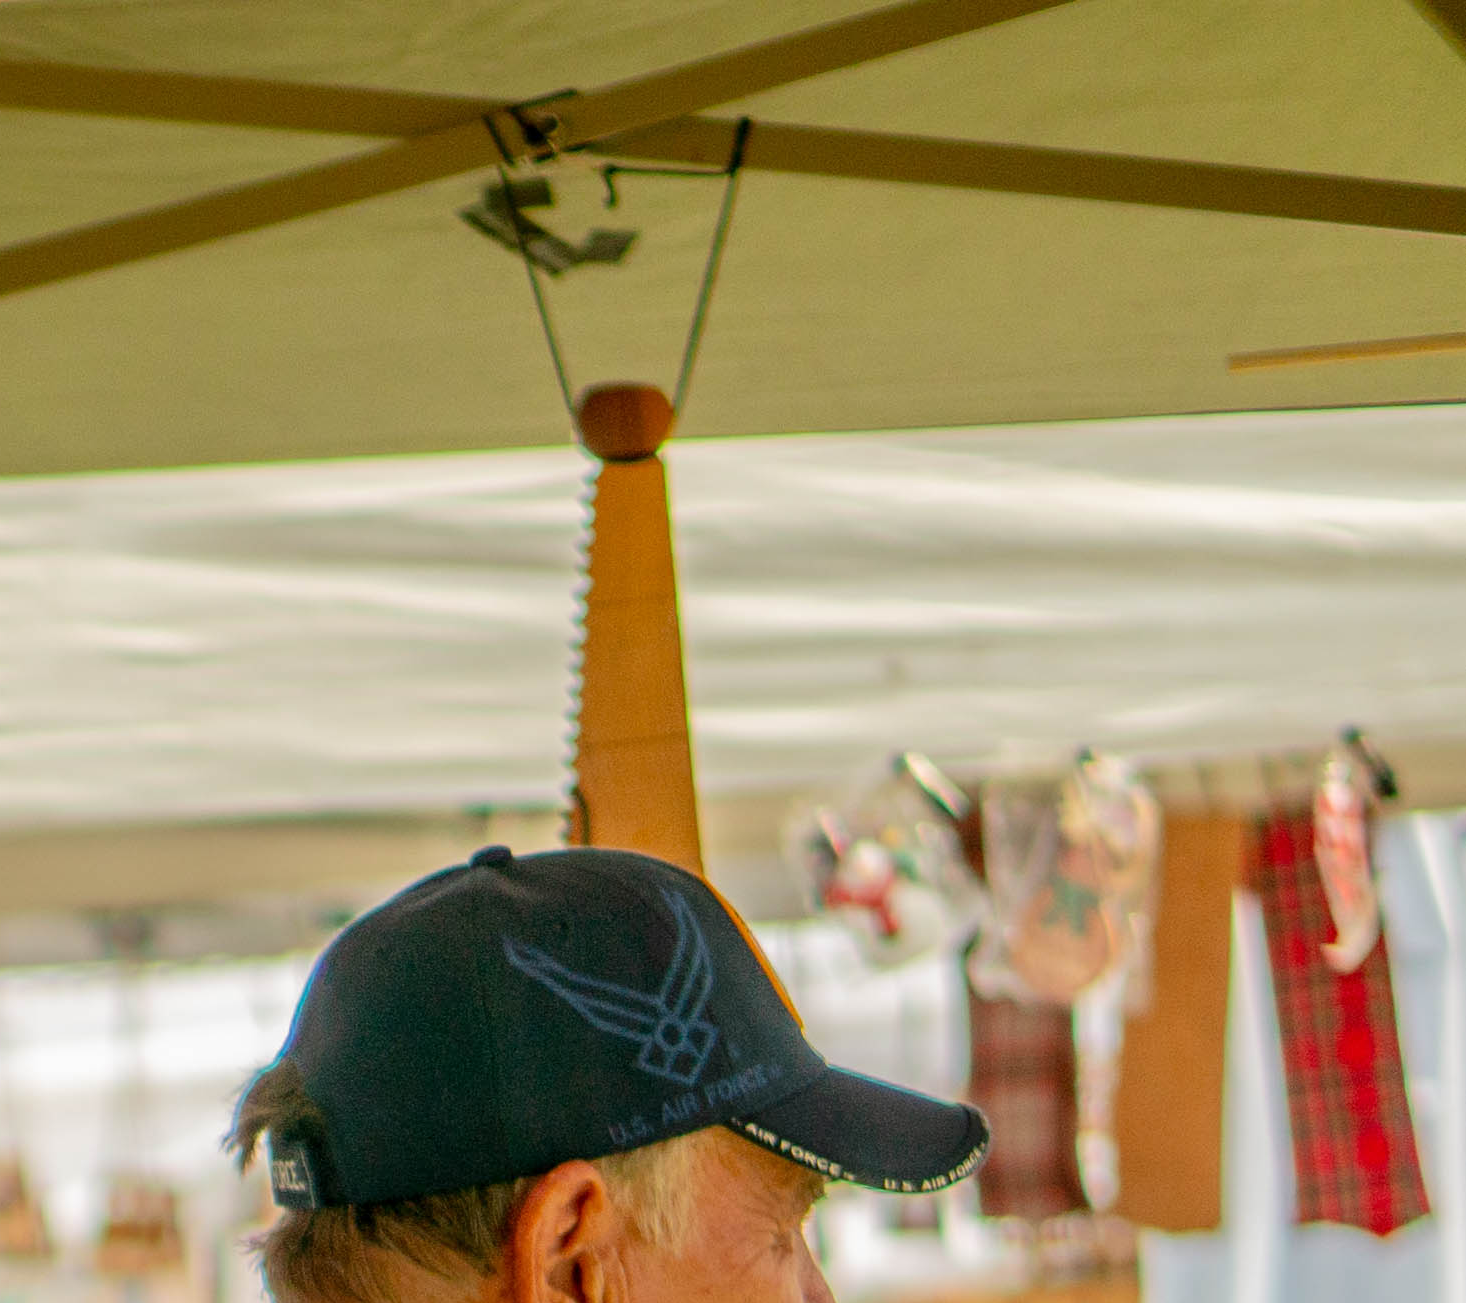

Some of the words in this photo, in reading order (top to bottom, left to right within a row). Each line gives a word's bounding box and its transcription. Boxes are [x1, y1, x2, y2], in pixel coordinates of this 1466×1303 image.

[662, 1091, 701, 1126] AIR
[703, 1063, 770, 1107] FORCE
[744, 1122, 778, 1147] AIR
[780, 1139, 842, 1178] FORCE
[921, 1174, 948, 1192] AIR
